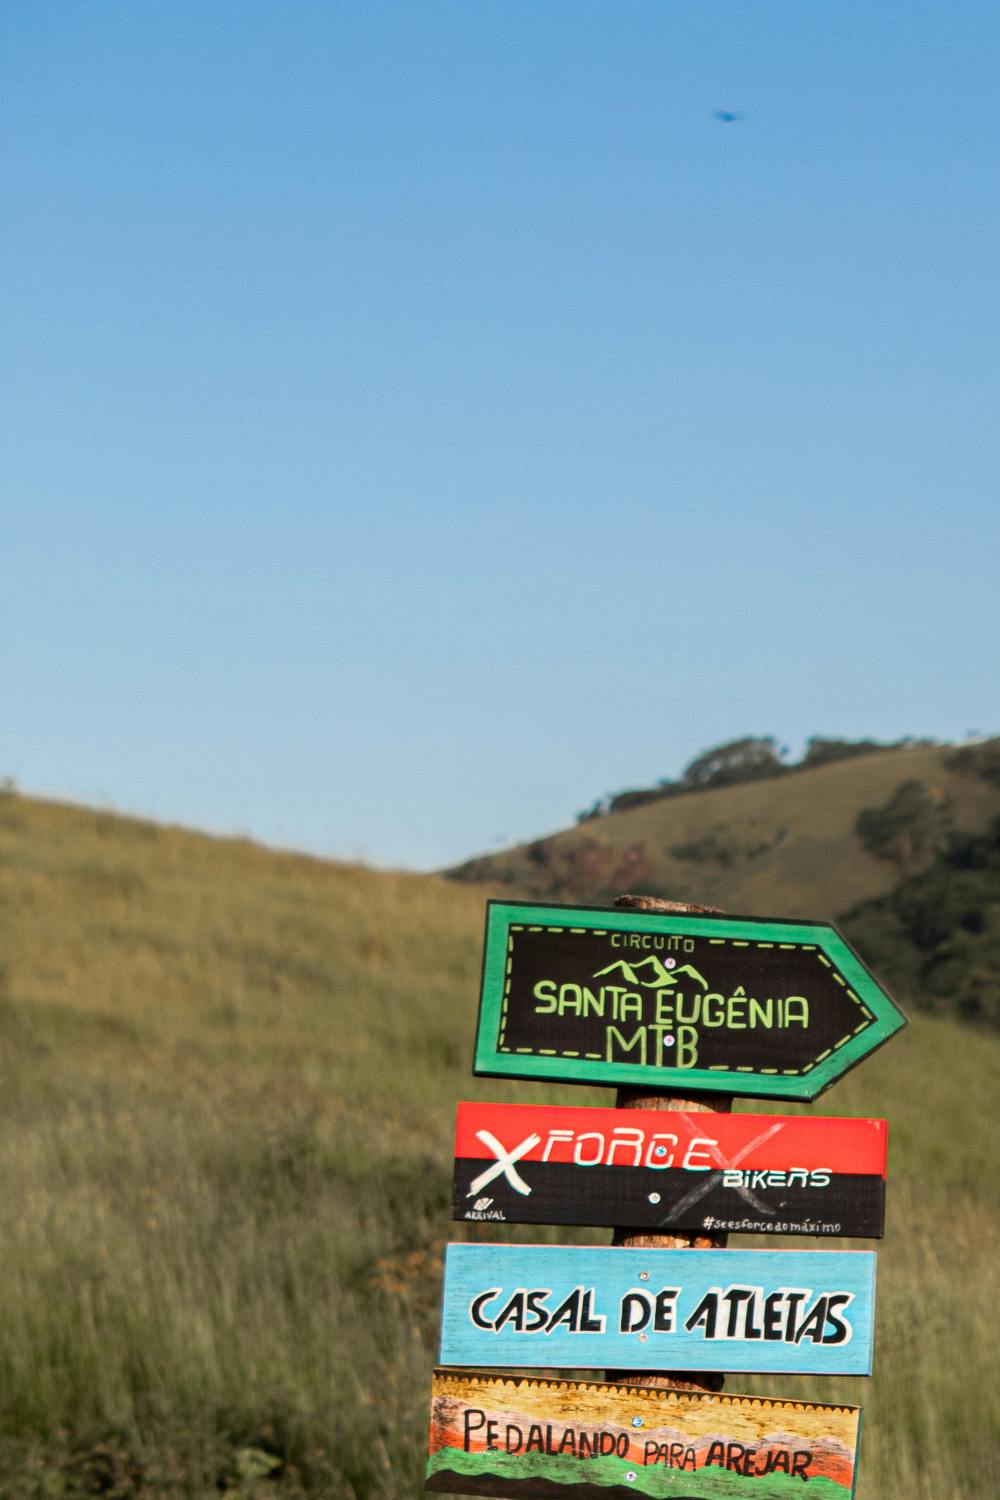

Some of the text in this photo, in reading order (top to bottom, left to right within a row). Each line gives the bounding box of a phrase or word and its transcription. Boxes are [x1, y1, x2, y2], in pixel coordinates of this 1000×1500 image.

[611, 934, 695, 953] CIRCUITO
[533, 980, 809, 1030] SANTA EUGÊNIA
[606, 1025, 699, 1069] MTB
[469, 1284, 855, 1347] CASAL DE ATLETAS
[464, 1409, 813, 1481] PEDALANDO PARA AREJAR
